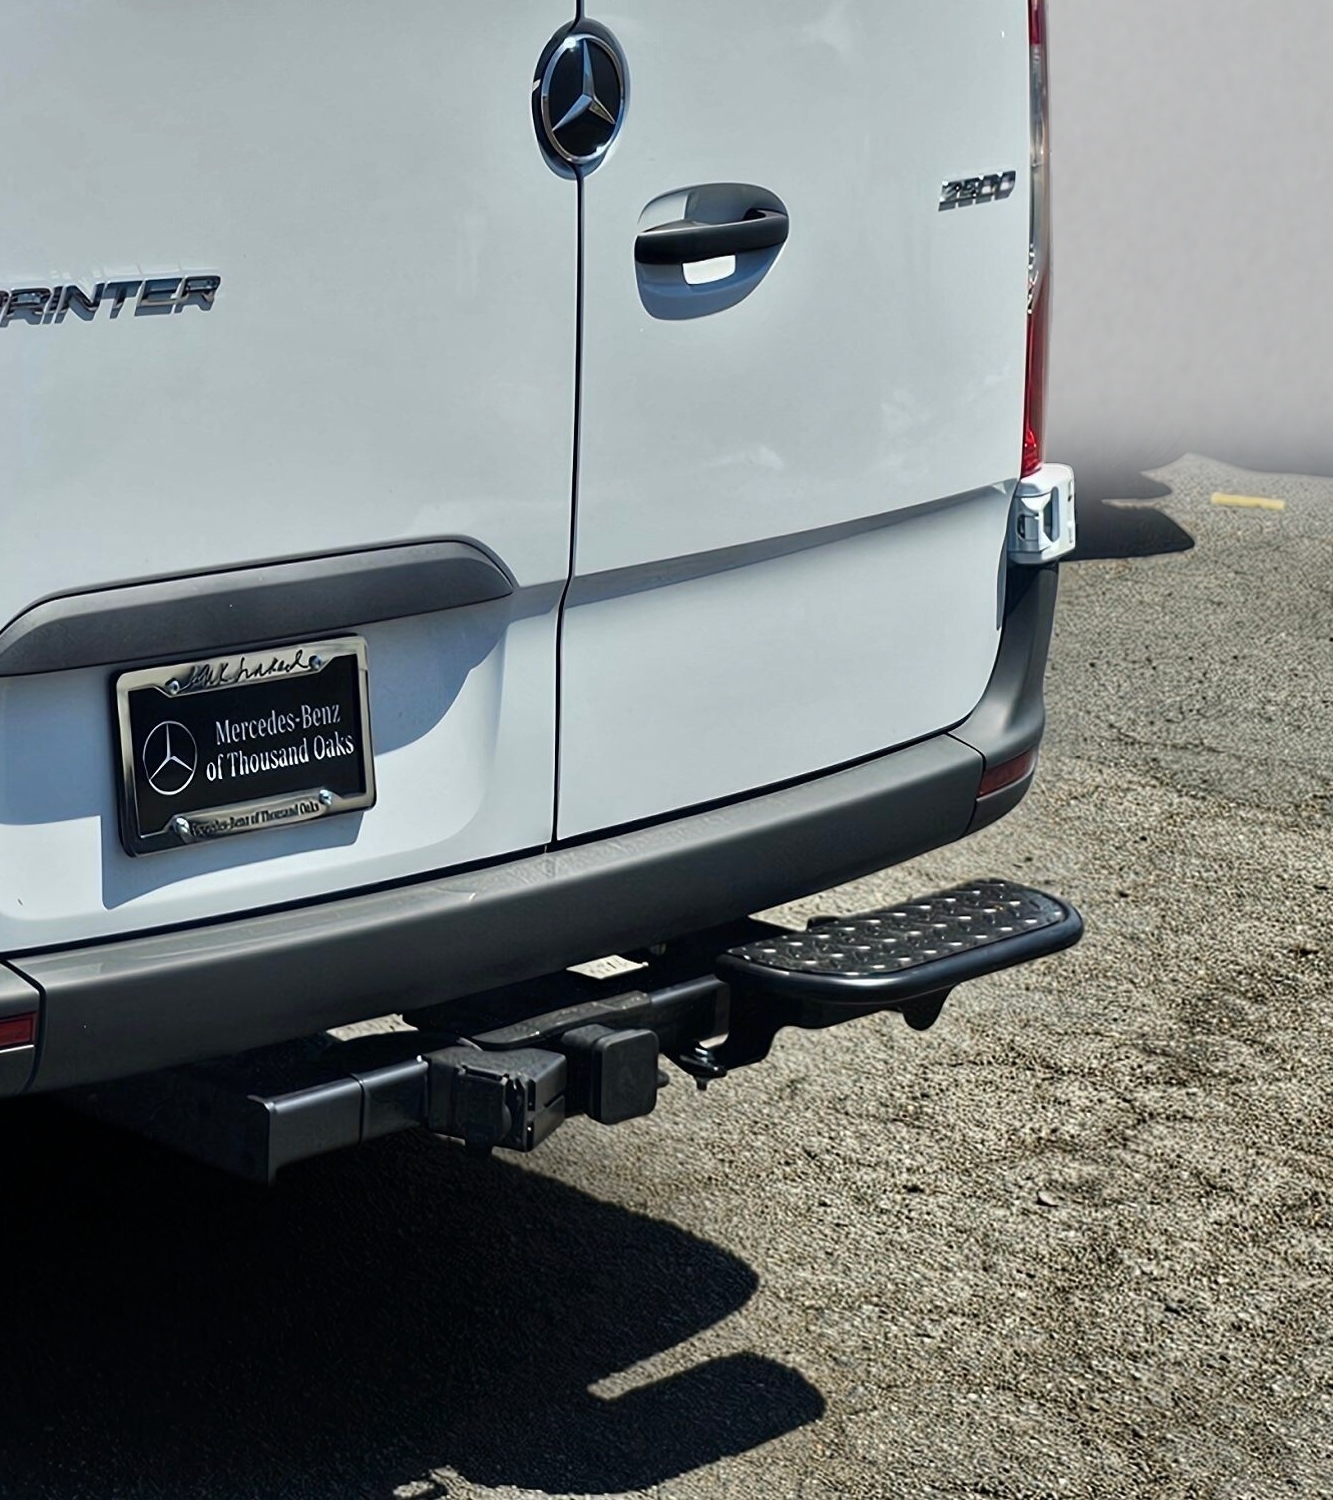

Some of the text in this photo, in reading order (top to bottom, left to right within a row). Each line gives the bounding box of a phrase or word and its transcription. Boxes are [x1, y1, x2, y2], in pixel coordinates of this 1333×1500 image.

[938, 170, 1016, 211] 2500
[215, 703, 342, 746] Mercedes-Benz
[206, 731, 355, 782] of Thousand Oaks
